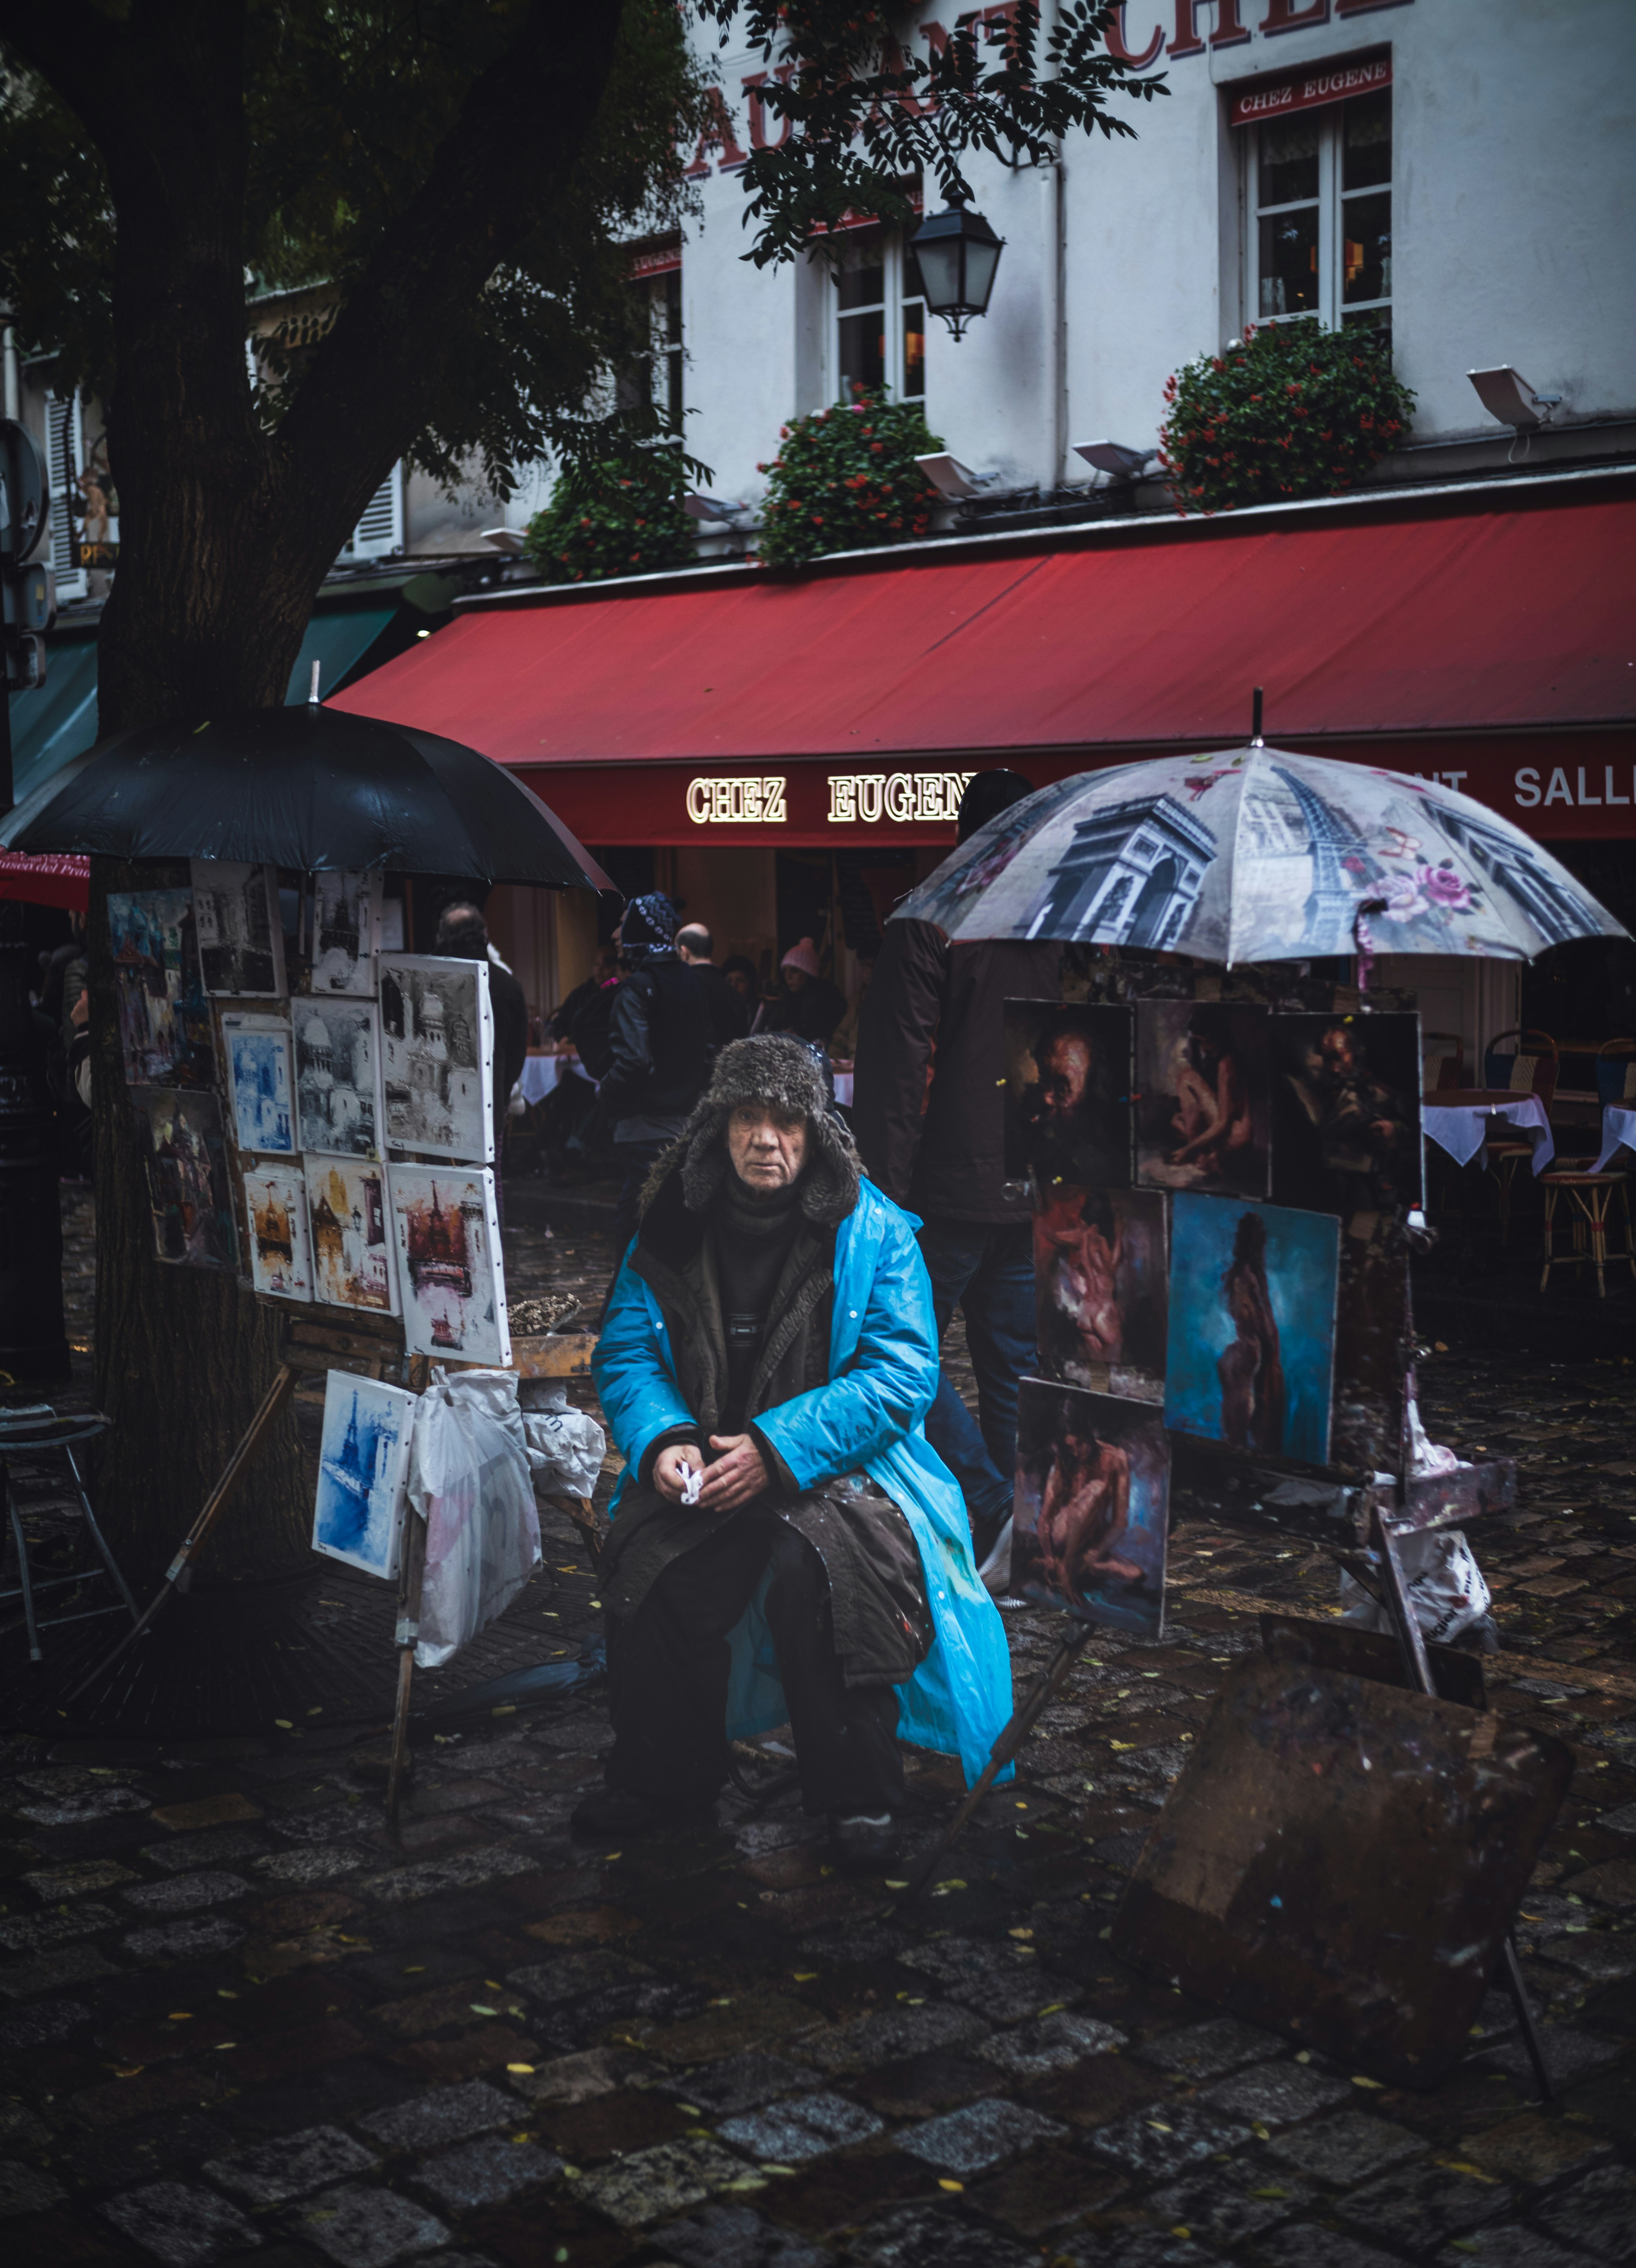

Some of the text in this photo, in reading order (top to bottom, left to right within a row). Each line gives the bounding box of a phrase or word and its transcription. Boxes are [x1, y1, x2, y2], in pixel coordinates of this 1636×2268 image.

[1240, 61, 1387, 114] CHEZ EUGENE
[686, 777, 787, 823] CHEZ
[1514, 765, 1636, 807] SALL
[36, 860, 58, 874] del
